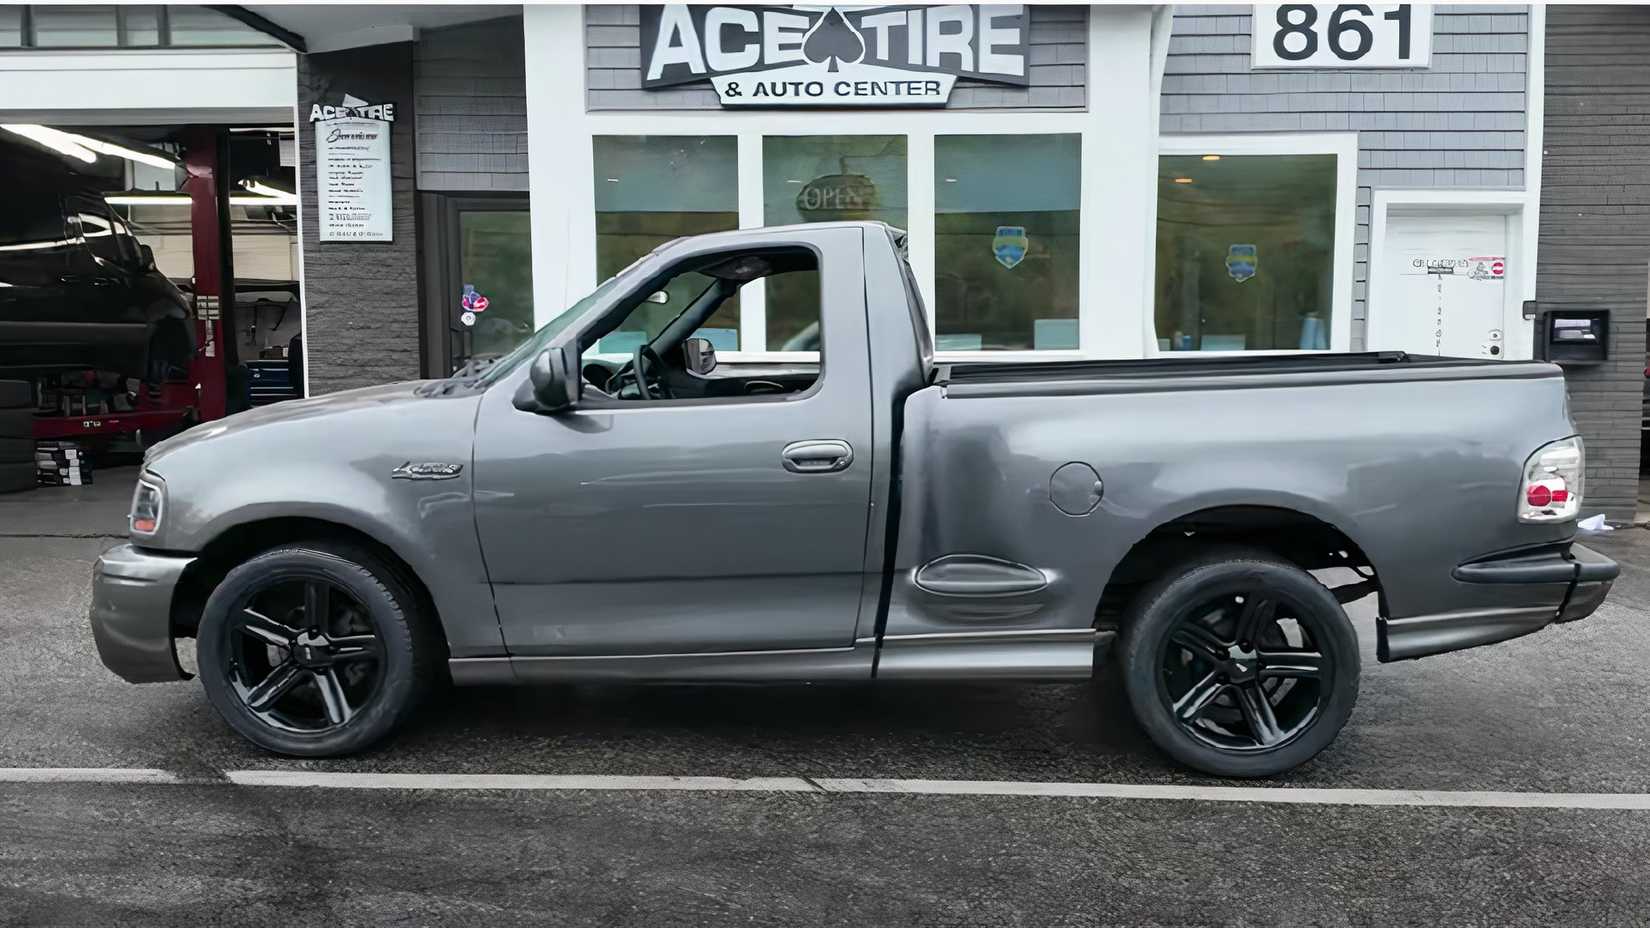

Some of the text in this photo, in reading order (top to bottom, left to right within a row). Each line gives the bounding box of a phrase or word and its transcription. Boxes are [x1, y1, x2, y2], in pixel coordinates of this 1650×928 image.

[647, 4, 1025, 80] ACE TIRE
[1273, 4, 1411, 61] 861
[725, 80, 941, 97] & AUTO CENTER
[309, 103, 347, 122] ACE
